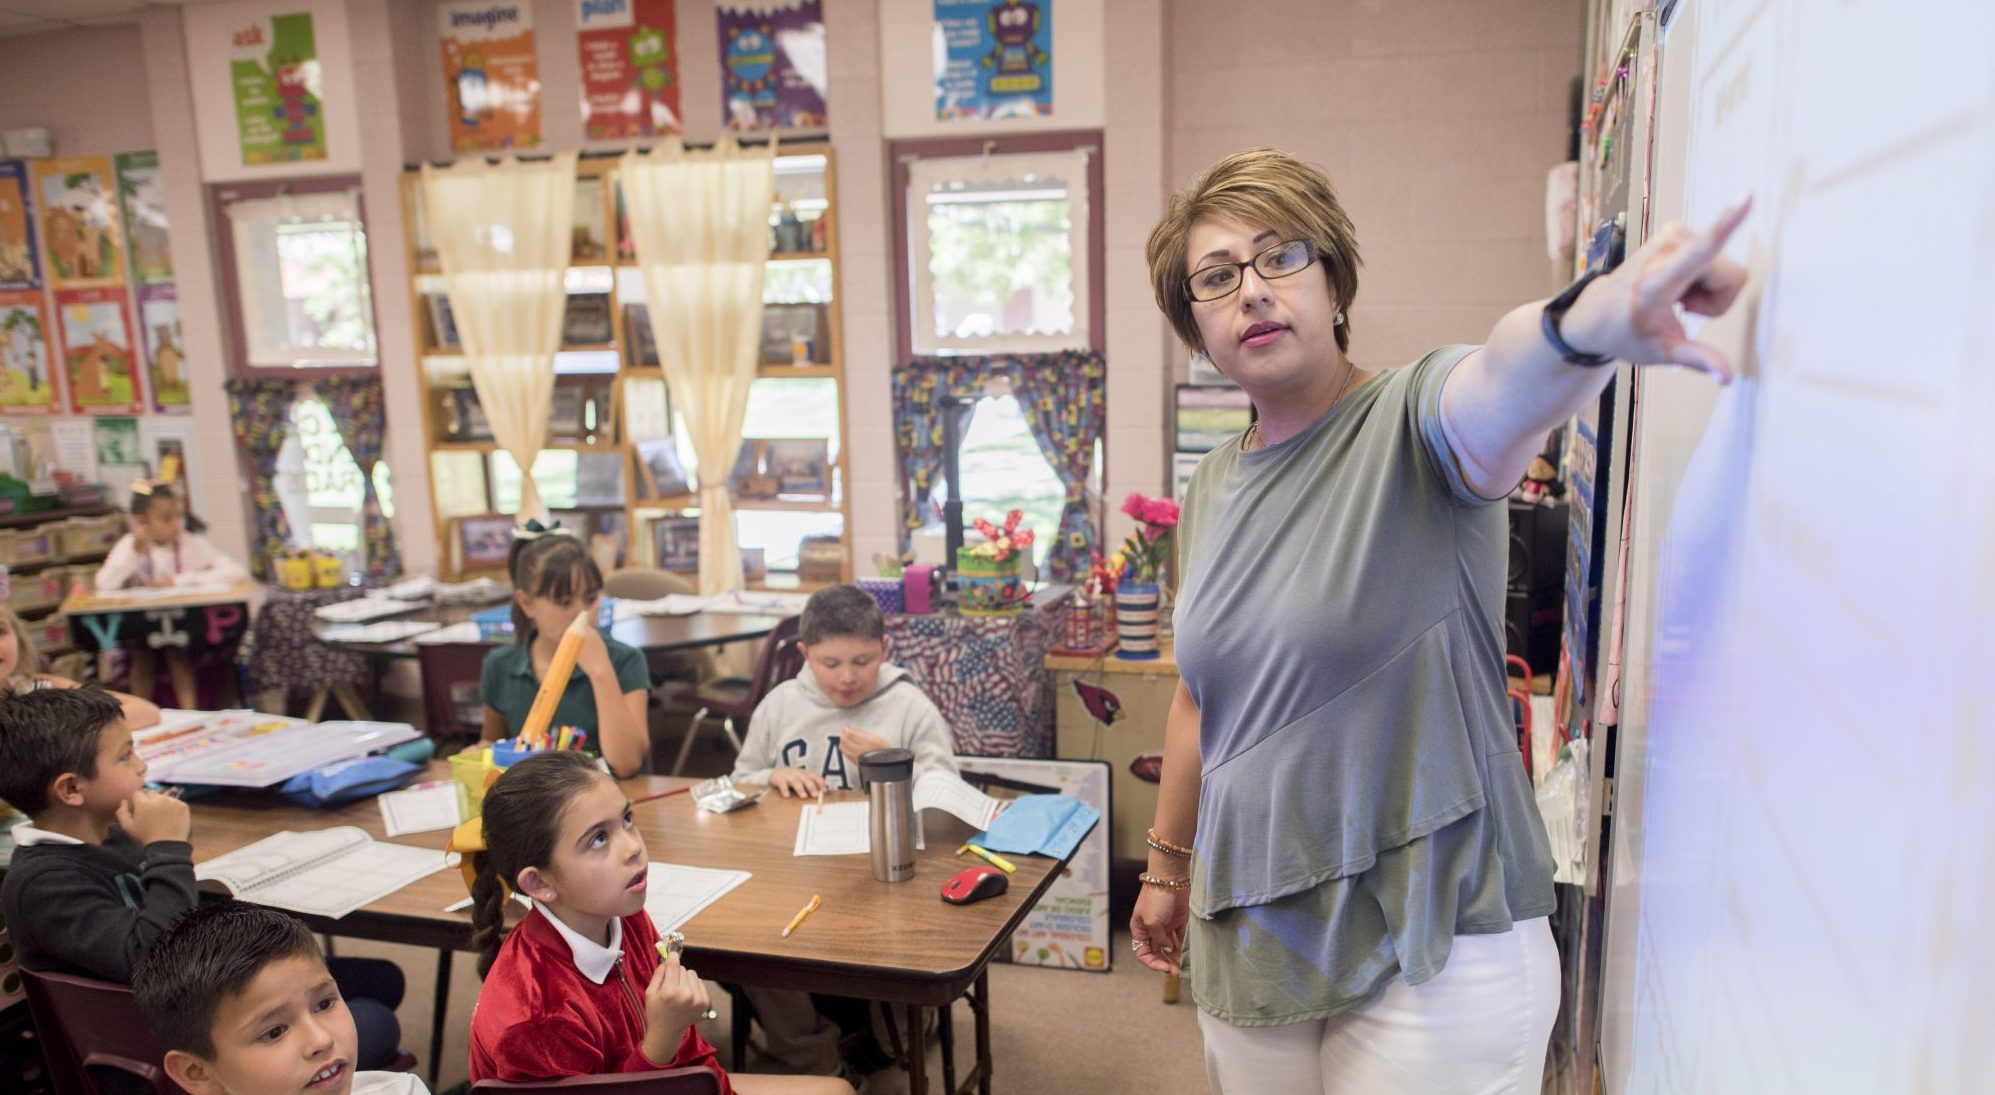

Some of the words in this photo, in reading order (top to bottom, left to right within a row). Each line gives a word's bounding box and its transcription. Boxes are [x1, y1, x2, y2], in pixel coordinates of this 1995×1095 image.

[451, 7, 518, 31] imagine
[232, 22, 265, 48] ask
[782, 736, 852, 791] GA
